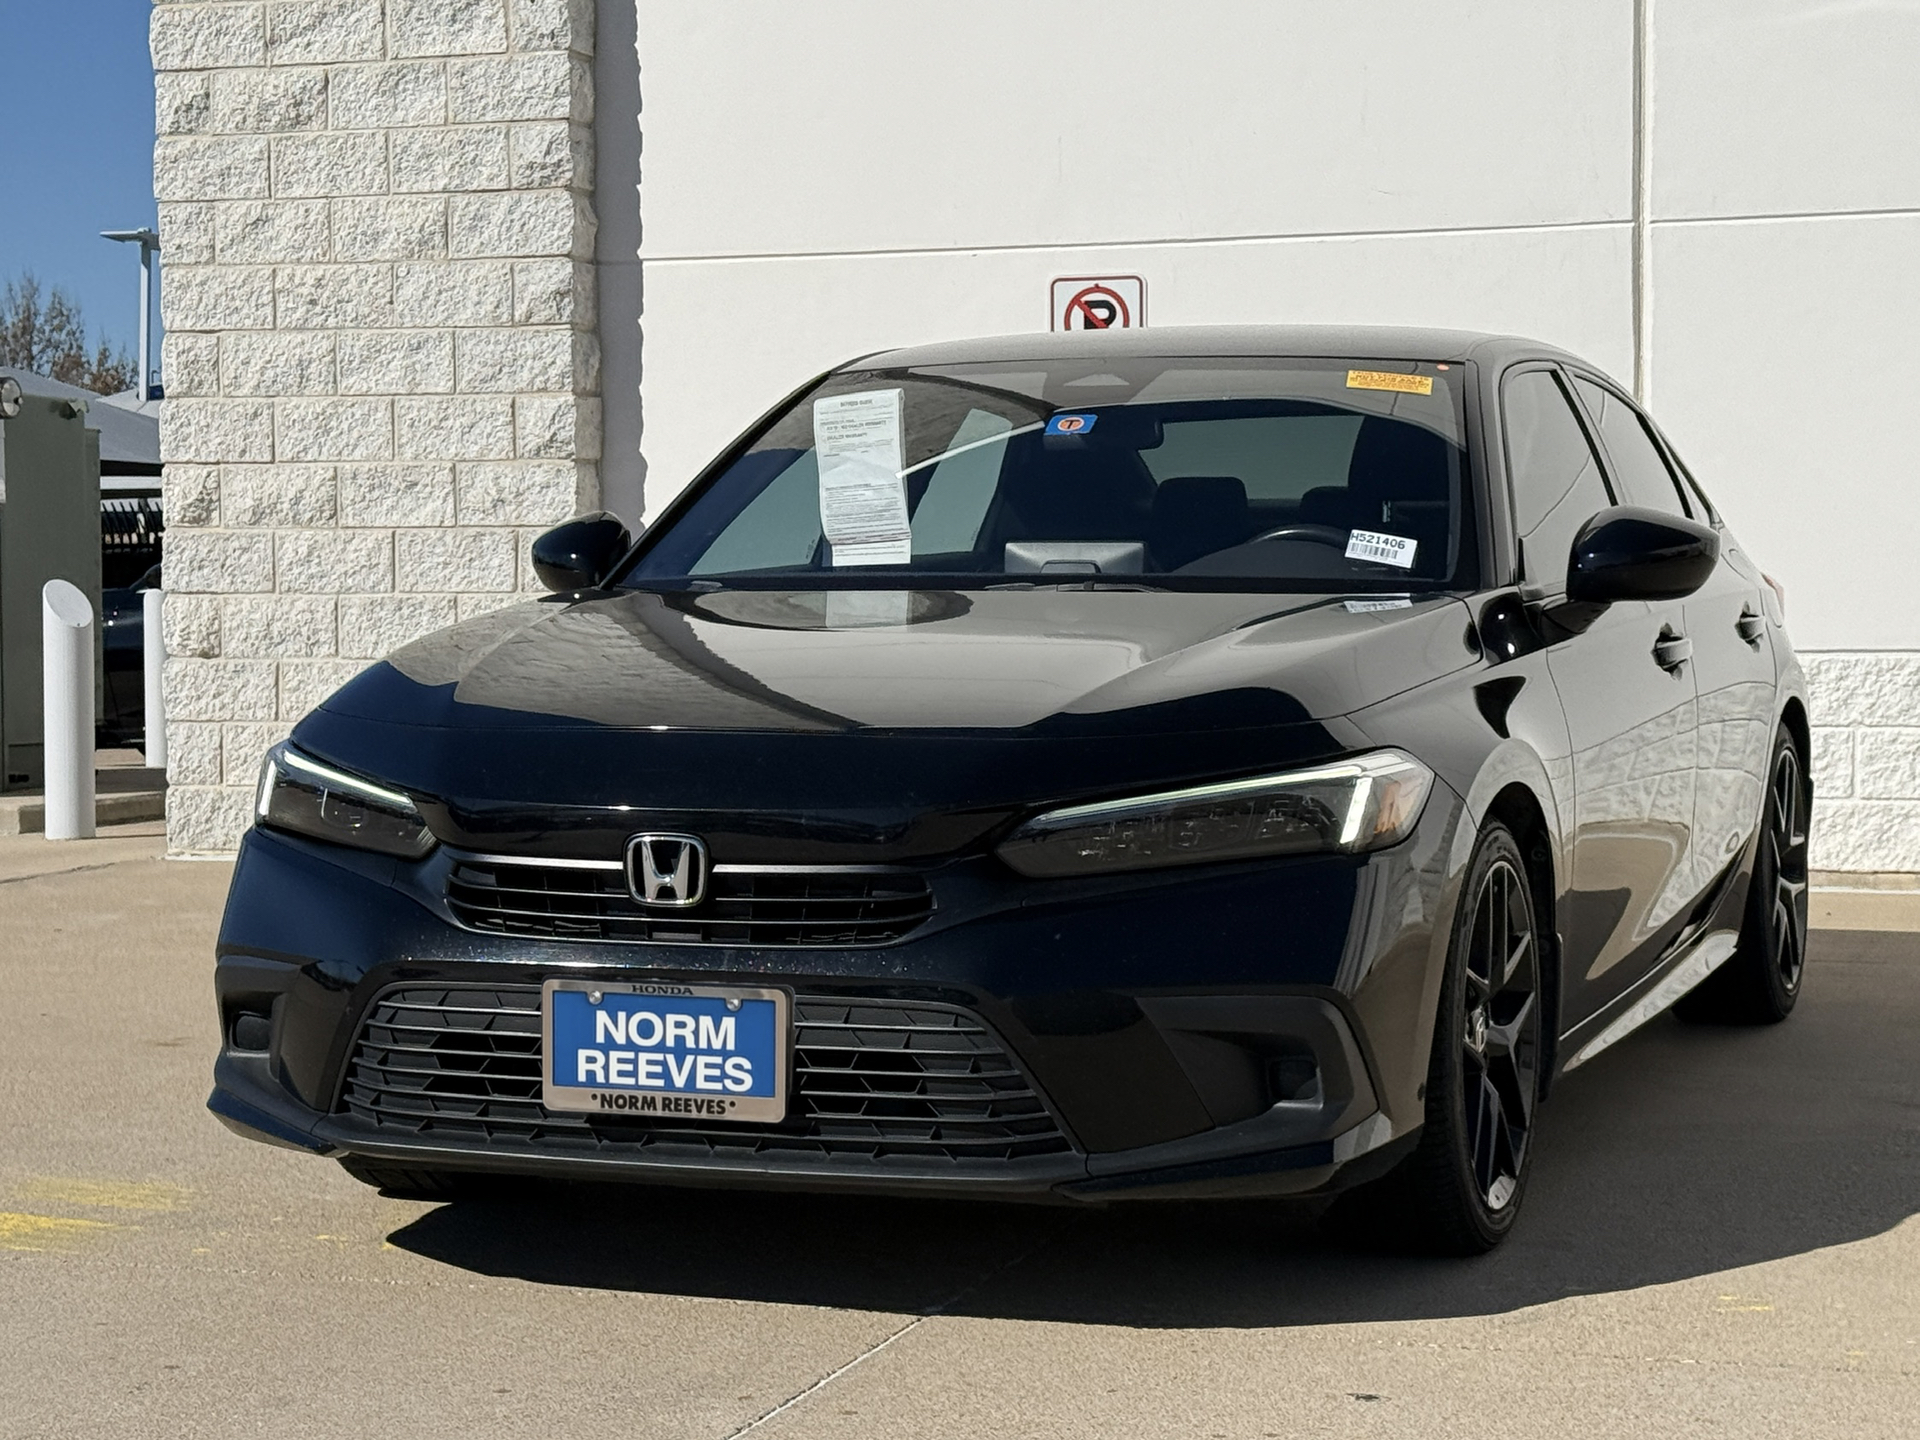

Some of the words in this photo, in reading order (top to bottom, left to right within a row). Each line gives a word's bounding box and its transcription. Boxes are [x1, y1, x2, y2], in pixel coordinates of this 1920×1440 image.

[1350, 532, 1406, 550] H521406
[631, 984, 694, 995] HONDA
[595, 1010, 736, 1051] NORM
[577, 1048, 753, 1092] REEVES
[600, 1094, 657, 1112] NORM
[661, 1097, 726, 1115] REEVES
